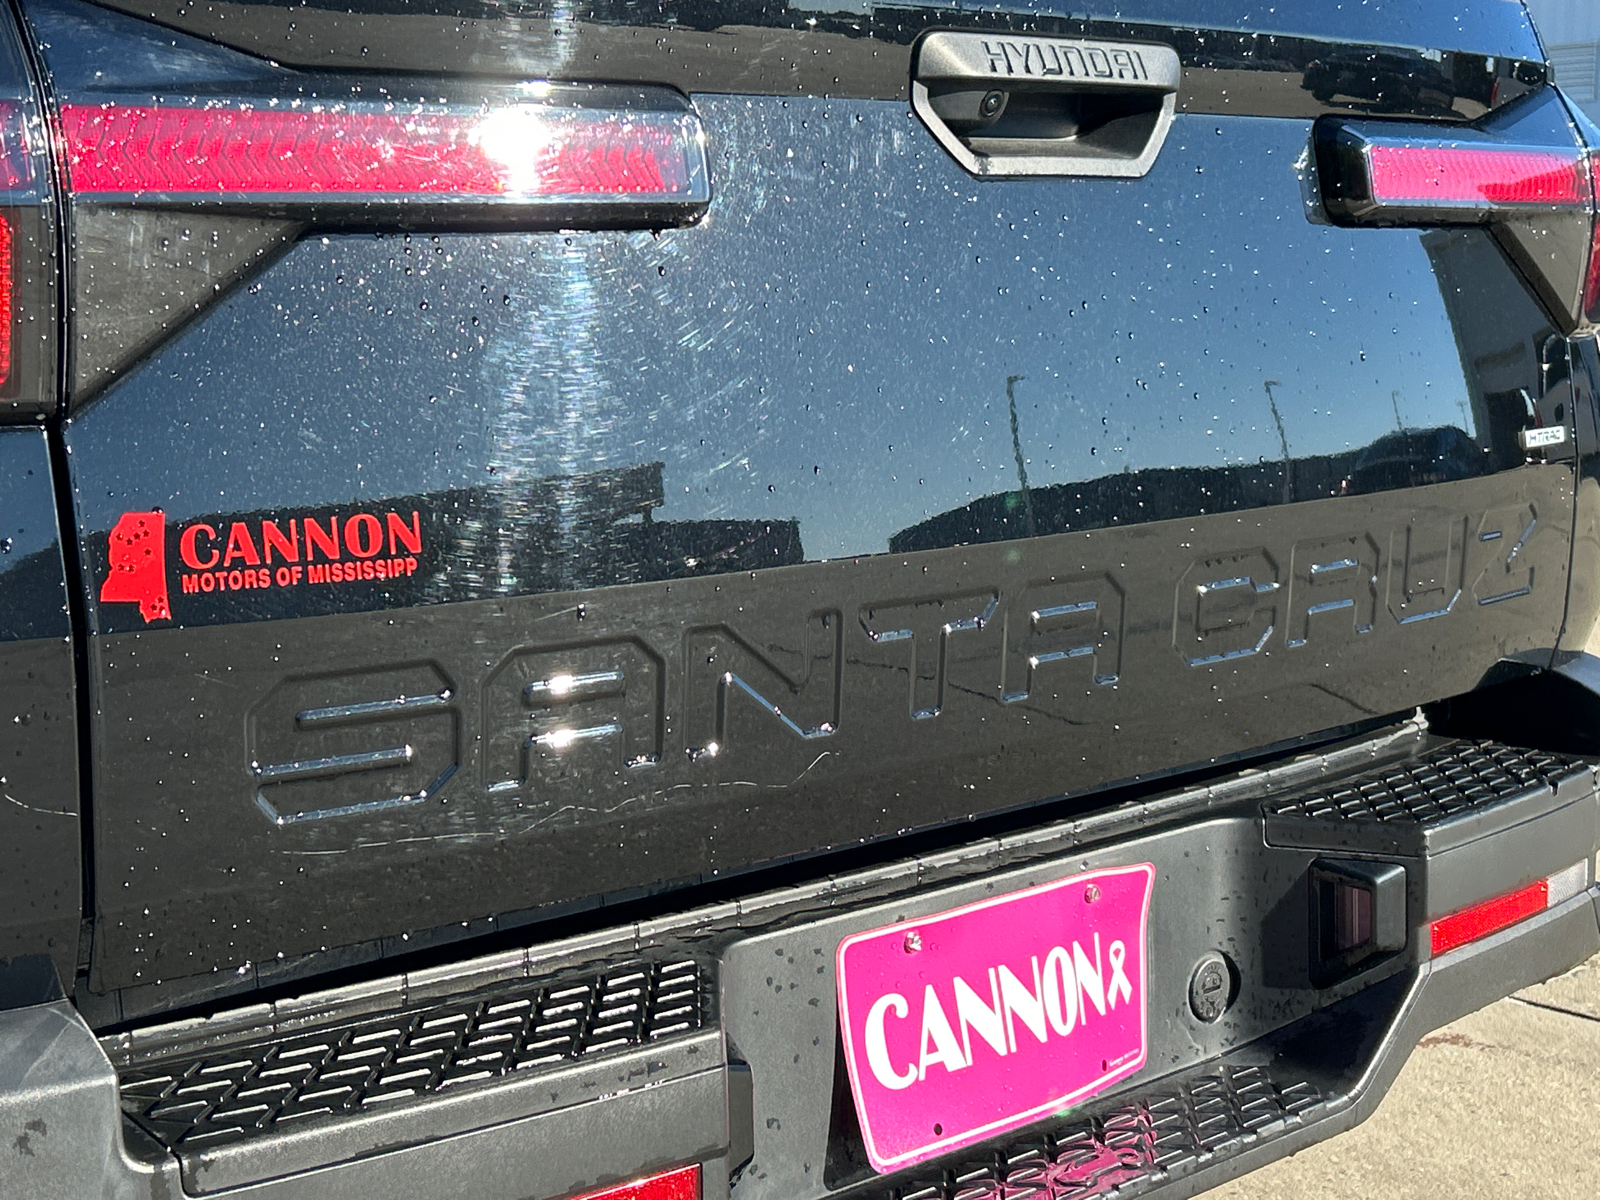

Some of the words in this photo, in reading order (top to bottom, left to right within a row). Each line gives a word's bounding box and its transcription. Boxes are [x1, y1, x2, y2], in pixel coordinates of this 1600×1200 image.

[982, 41, 1149, 80] HYUNDAI
[180, 511, 423, 569] CANNON
[182, 569, 271, 593] MOTORS
[276, 566, 302, 586] OF
[244, 569, 1126, 825] SANTA
[1173, 502, 1537, 667] CRUZ
[865, 931, 1106, 1090] CANNON
